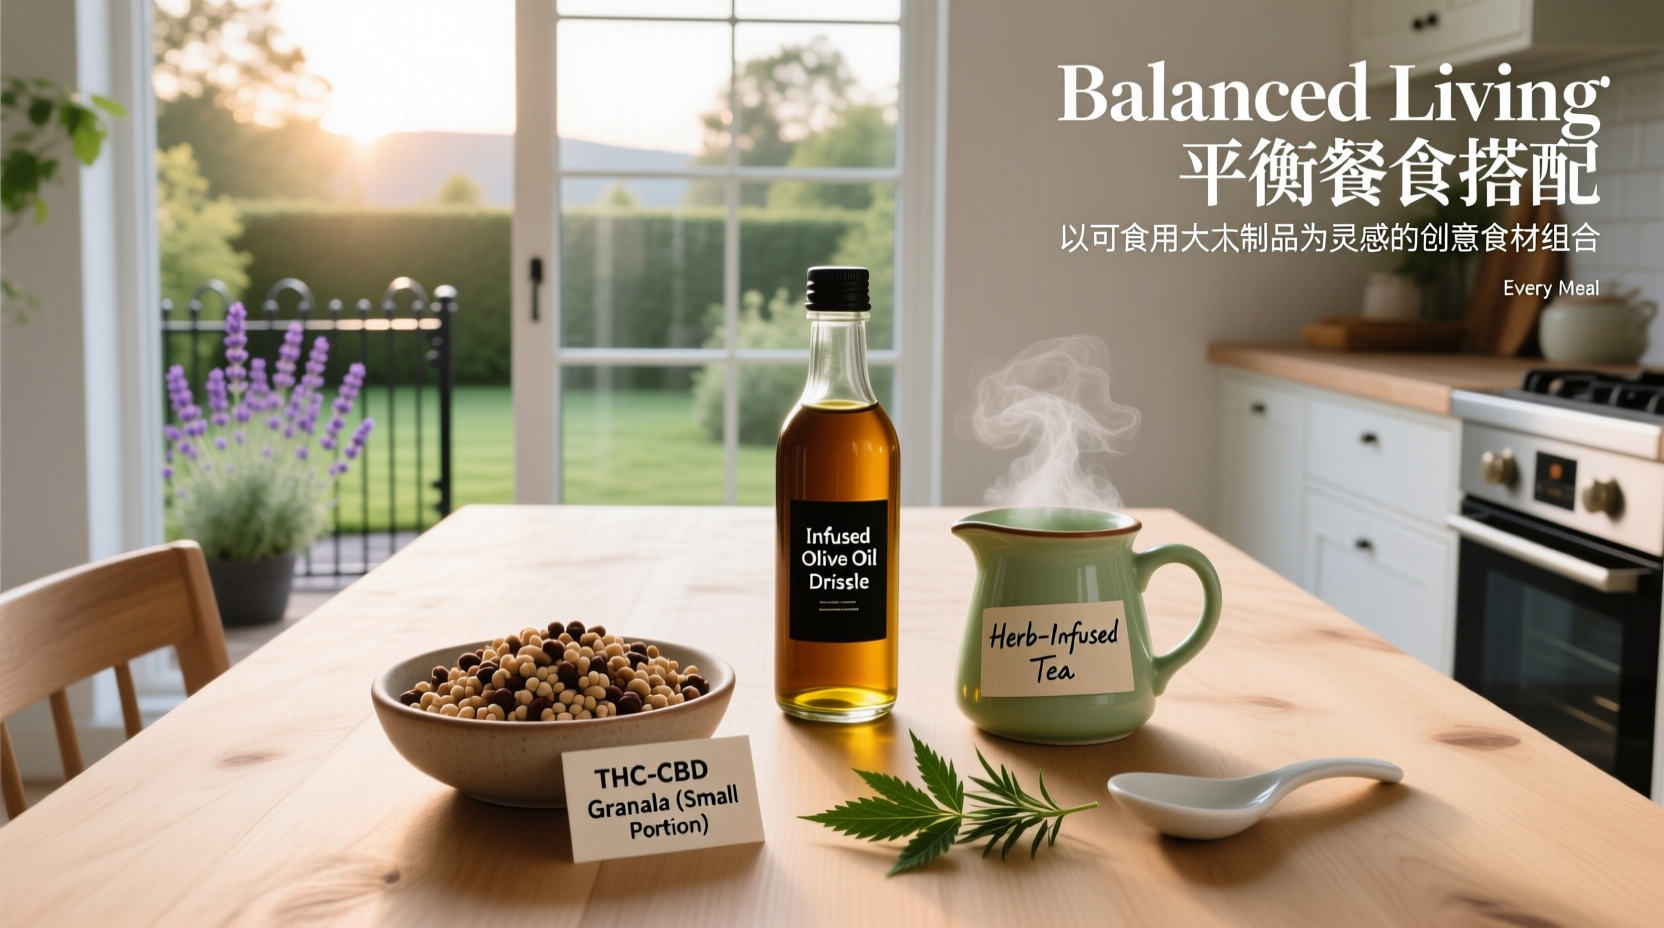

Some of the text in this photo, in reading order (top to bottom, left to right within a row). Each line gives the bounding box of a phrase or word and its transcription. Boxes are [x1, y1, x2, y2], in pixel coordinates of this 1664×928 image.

[806, 525, 871, 545] Infused
[801, 547, 877, 567] Olive Oil
[989, 618, 1119, 655] Herb-Infused
[1029, 654, 1076, 684] Tea
[594, 759, 708, 789] THC-CBD
[587, 784, 739, 819] Granala (Small
[630, 813, 709, 840] Portion)
